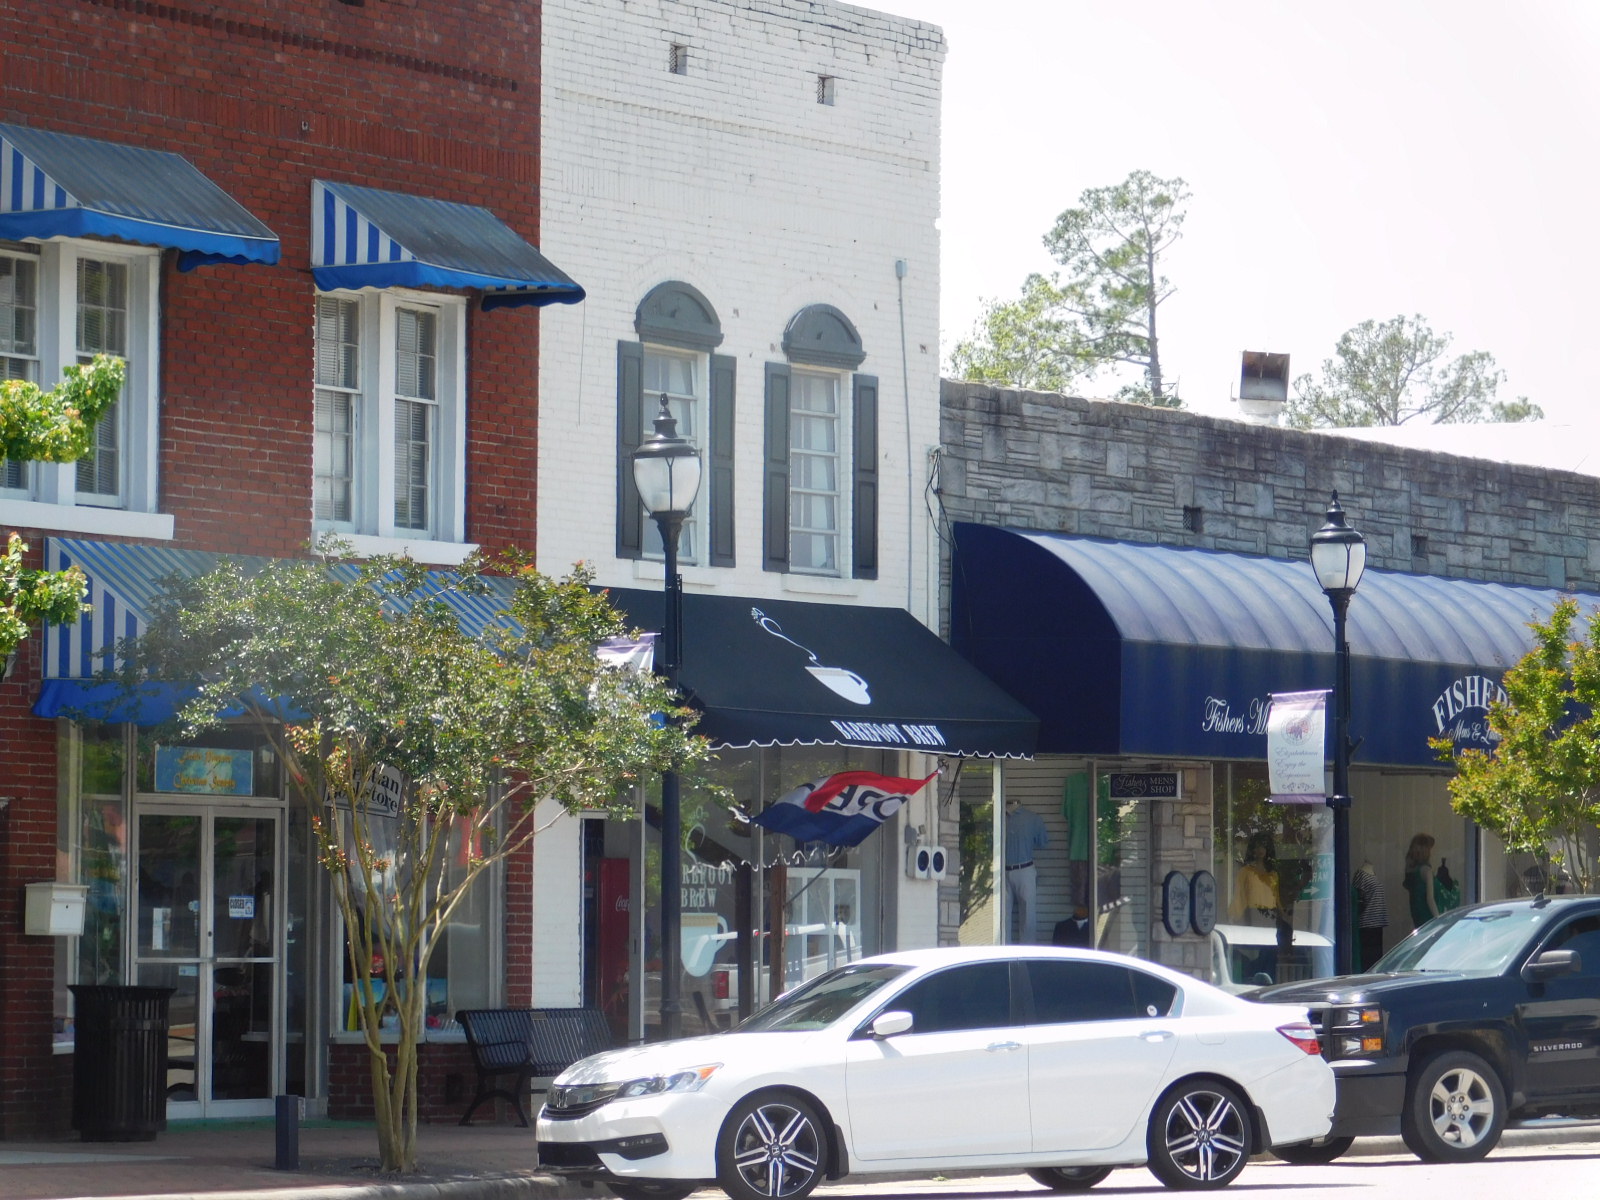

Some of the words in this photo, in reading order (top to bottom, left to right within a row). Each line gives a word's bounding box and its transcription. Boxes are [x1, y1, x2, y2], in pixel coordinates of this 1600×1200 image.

[830, 720, 908, 743] BAREFOOT
[902, 724, 946, 746] BREW
[1150, 777, 1175, 785] MENS
[681, 864, 734, 885] REFOOT
[681, 888, 717, 908] BREW
[1533, 1042, 1583, 1052] SILVERADO
